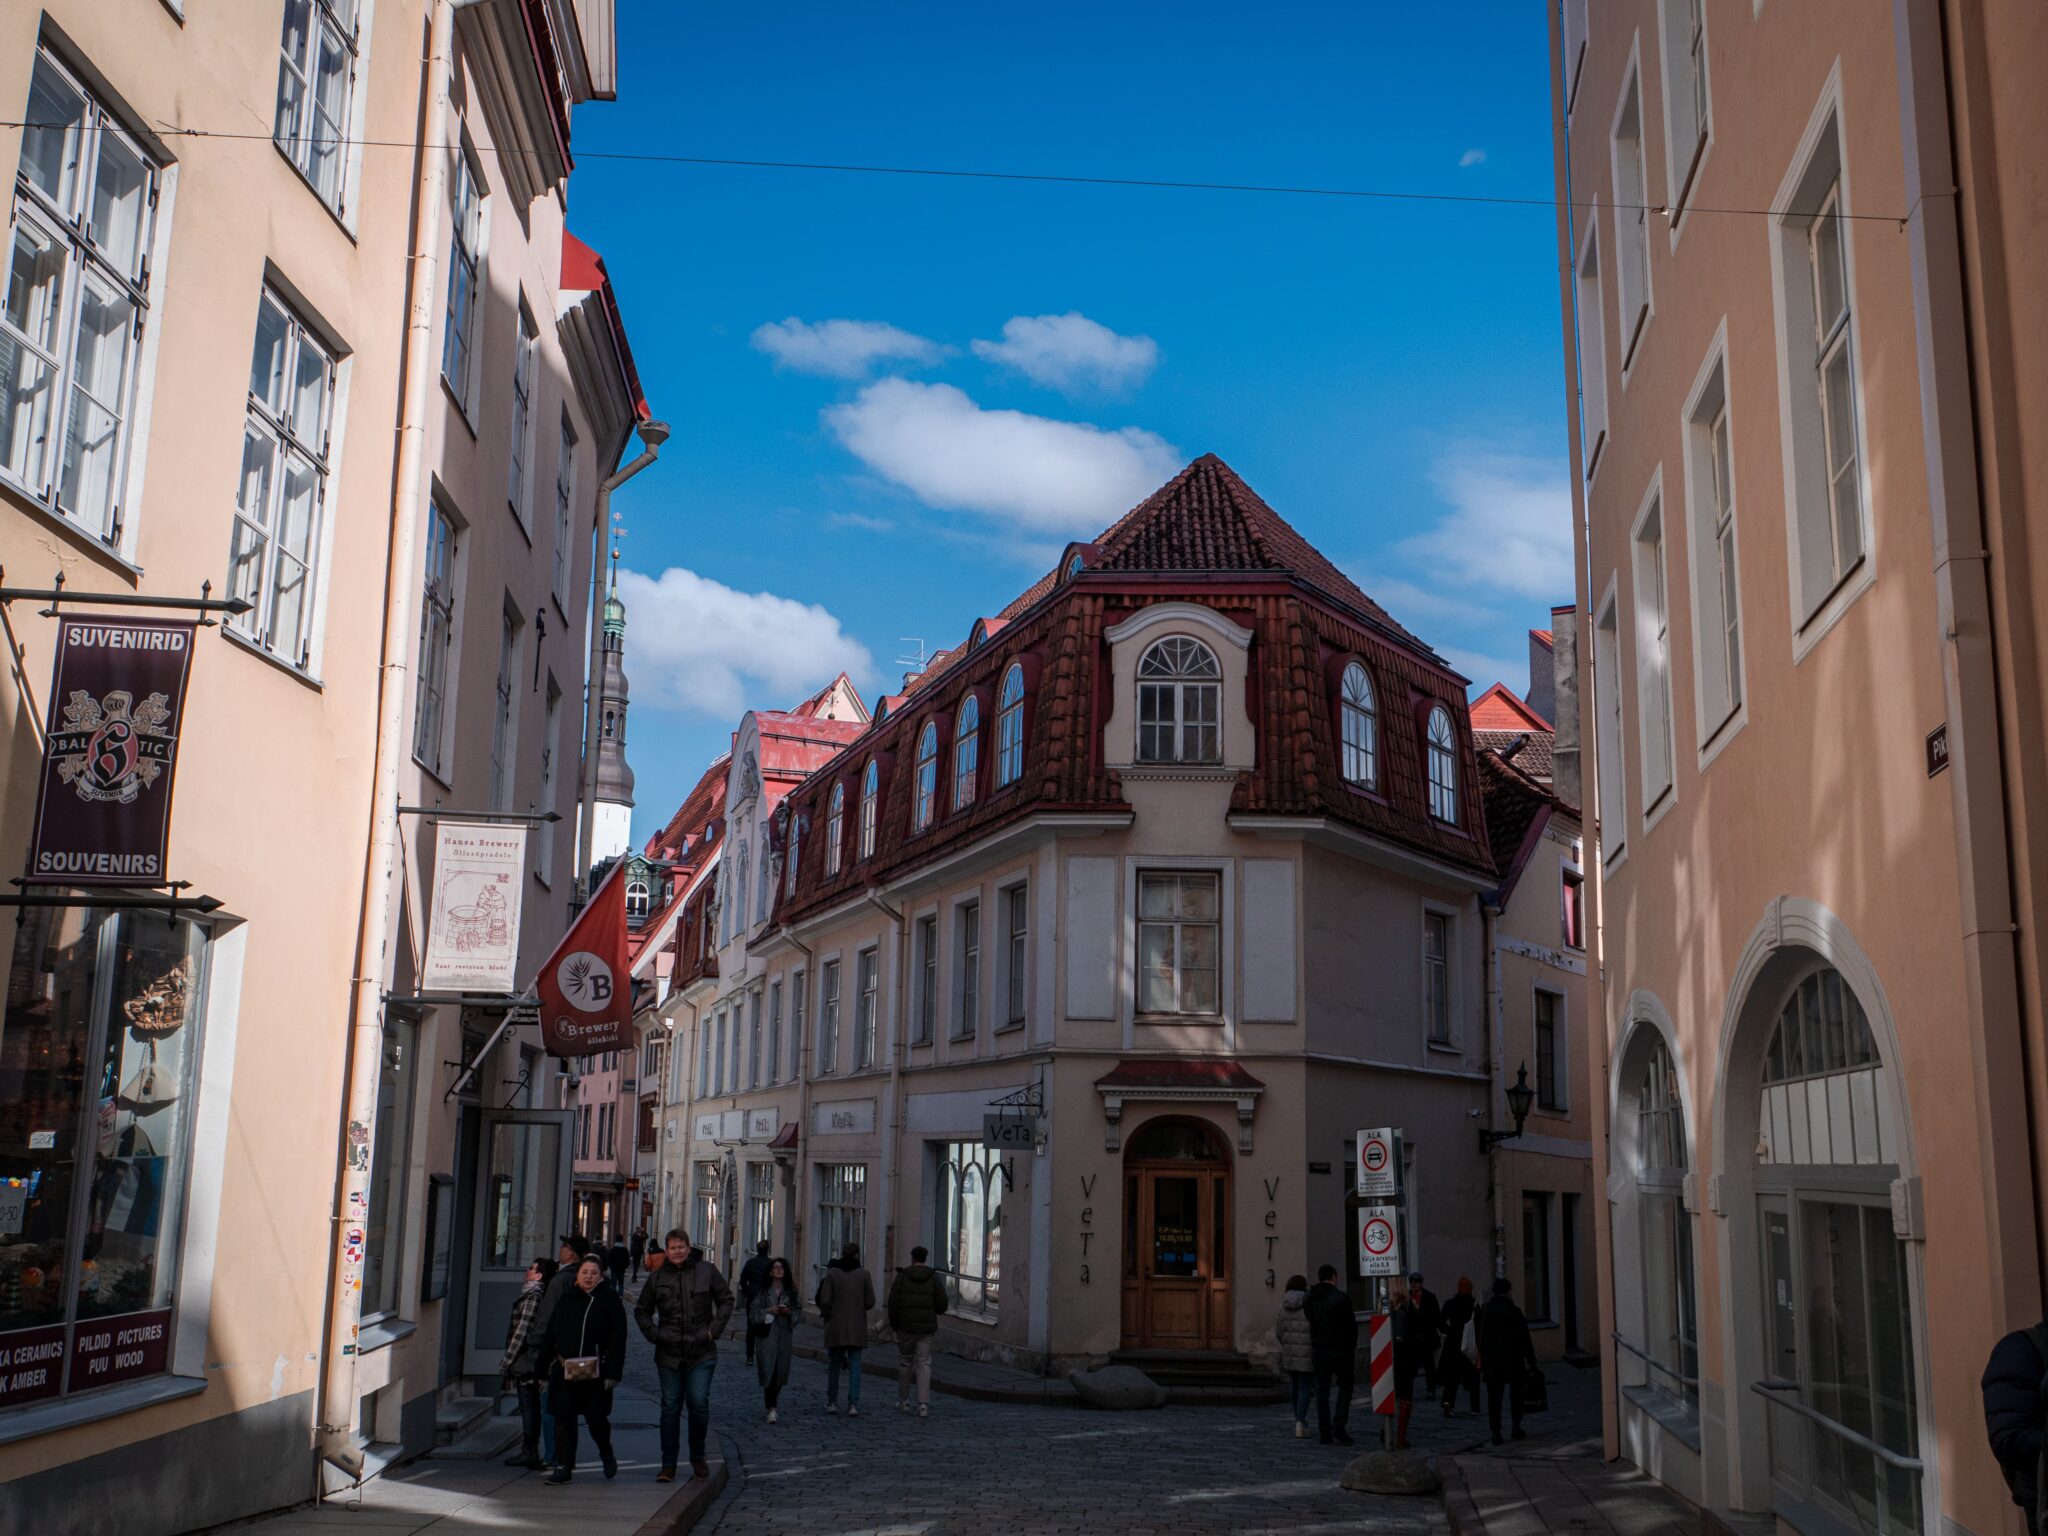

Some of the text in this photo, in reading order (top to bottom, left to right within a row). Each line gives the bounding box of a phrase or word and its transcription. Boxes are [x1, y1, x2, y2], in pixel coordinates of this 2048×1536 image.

[68, 627, 185, 651] SUVENIIRID
[59, 737, 164, 755] BAL TIC
[444, 837, 520, 849] Hansa Brewery
[39, 850, 158, 874] SOUVENIRS
[589, 974, 612, 1001] B
[568, 1020, 620, 1036] Brewery
[990, 1124, 1030, 1141] VeTa
[1367, 1131, 1382, 1140] ALA
[1369, 1209, 1385, 1218] ALA
[1080, 1173, 1096, 1285] VeTa
[1264, 1176, 1280, 1289] VeTa
[78, 1324, 163, 1353] PILDID PICTURES
[13, 1341, 63, 1365] CERAMICS
[88, 1350, 144, 1375] PUU WOOD
[10, 1368, 47, 1391] AMBER
